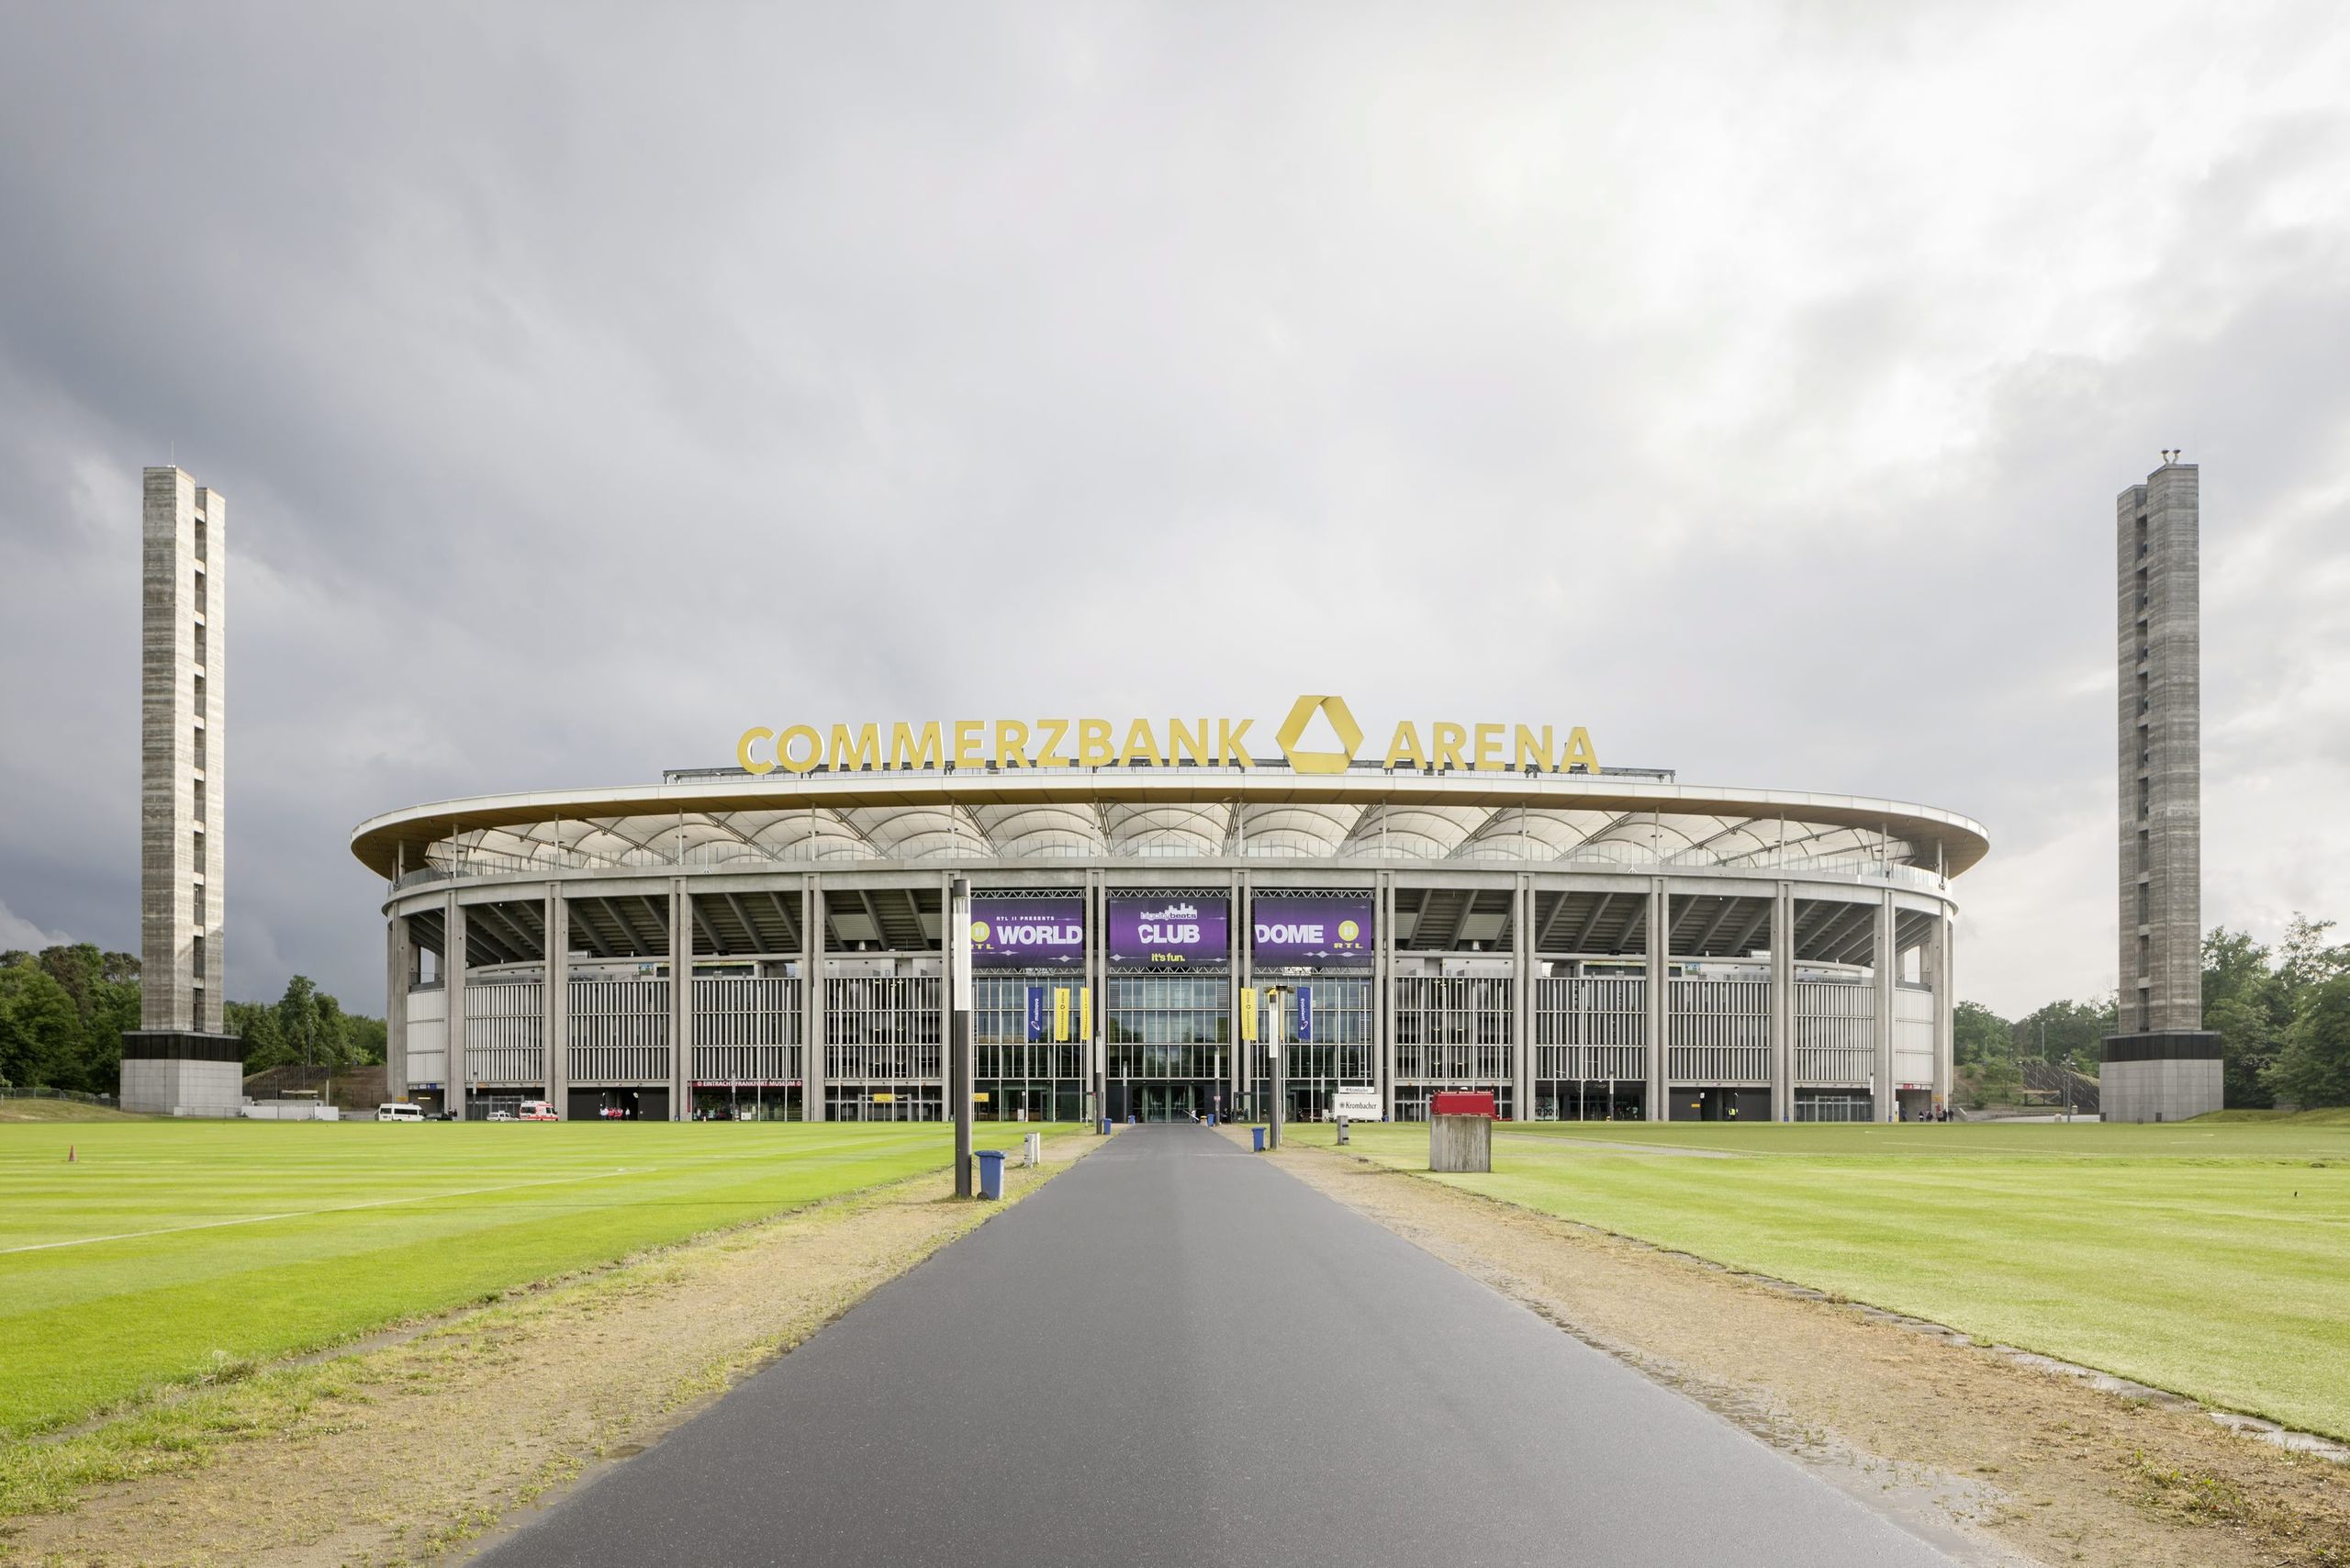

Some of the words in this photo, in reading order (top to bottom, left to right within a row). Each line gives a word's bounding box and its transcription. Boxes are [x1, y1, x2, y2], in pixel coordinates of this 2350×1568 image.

[737, 718, 1256, 776] COMMERZBANK
[1382, 721, 1601, 775] ARENA
[996, 925, 1083, 945] WORLD
[1138, 924, 1200, 944] CLUB
[1254, 924, 1324, 944] DOME
[1167, 953, 1185, 961] fun.
